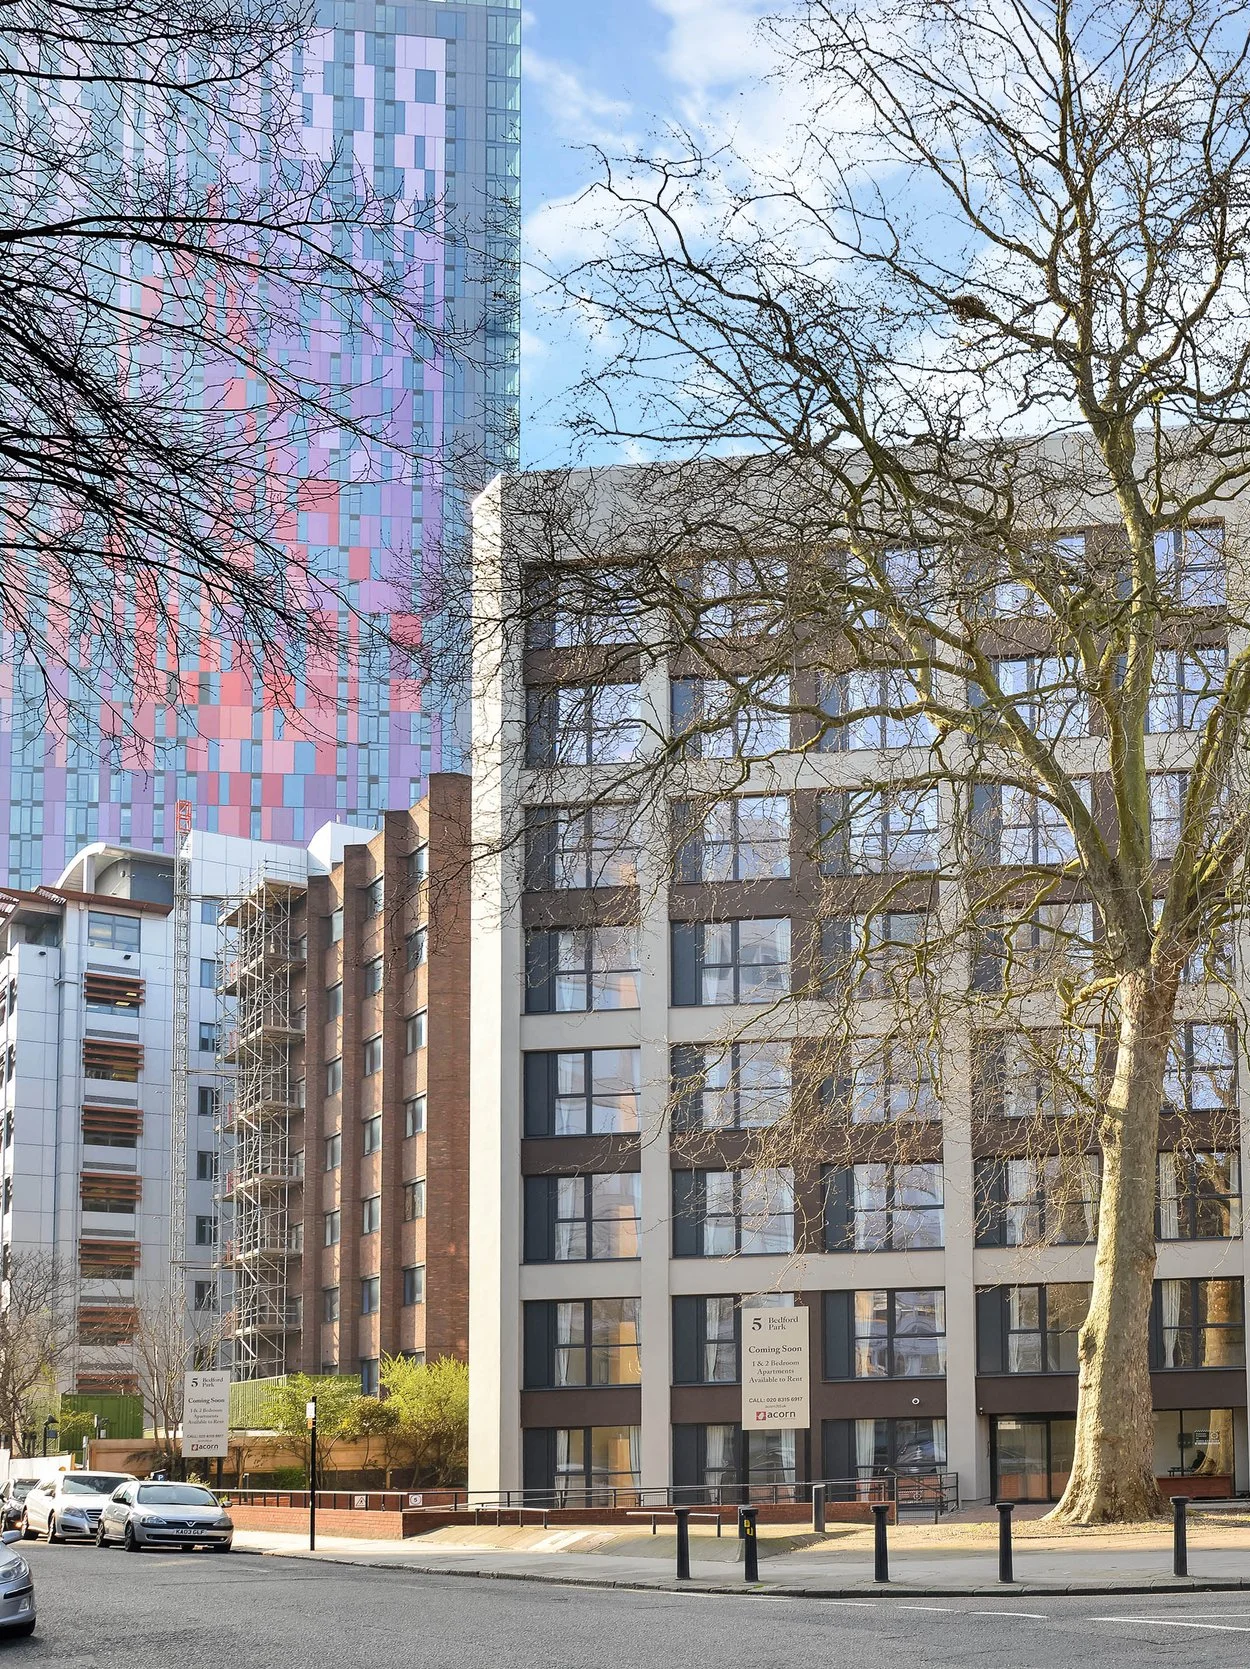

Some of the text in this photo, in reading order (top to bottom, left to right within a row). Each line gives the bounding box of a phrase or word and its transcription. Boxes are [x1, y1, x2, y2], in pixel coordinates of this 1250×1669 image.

[751, 1317, 762, 1331] 5
[748, 1344, 802, 1355] Coming Soon
[770, 1359, 800, 1367] Bedroom
[757, 1368, 795, 1376] Apartments
[191, 1377, 199, 1388] 5
[748, 1376, 778, 1384] Available
[767, 1411, 796, 1419] acorn
